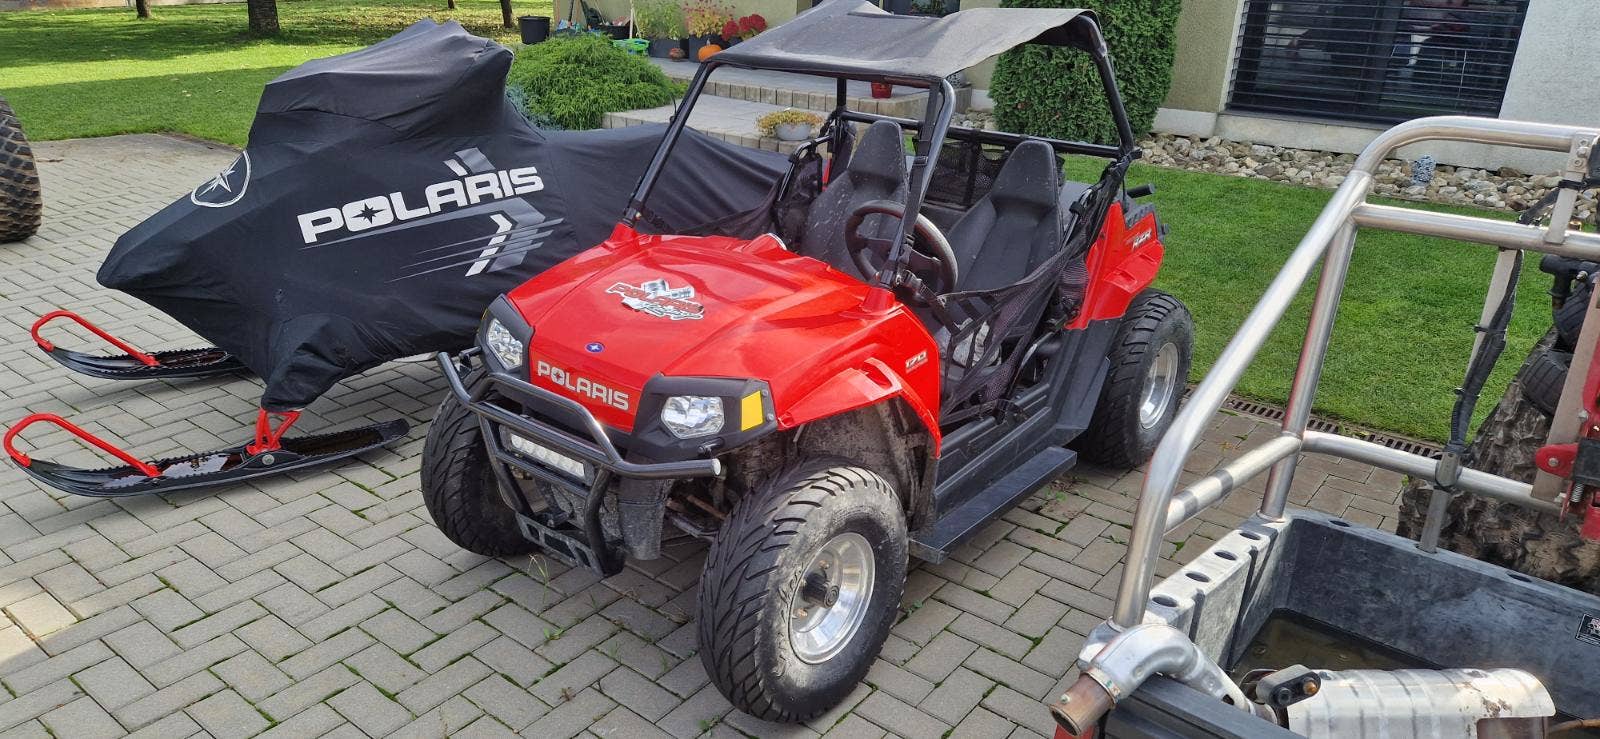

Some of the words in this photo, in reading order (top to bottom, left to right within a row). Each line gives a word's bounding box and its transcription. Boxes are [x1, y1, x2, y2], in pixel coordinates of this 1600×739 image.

[297, 166, 545, 244] POLARIS
[905, 350, 928, 369] 170
[537, 360, 629, 411] POLARIS
